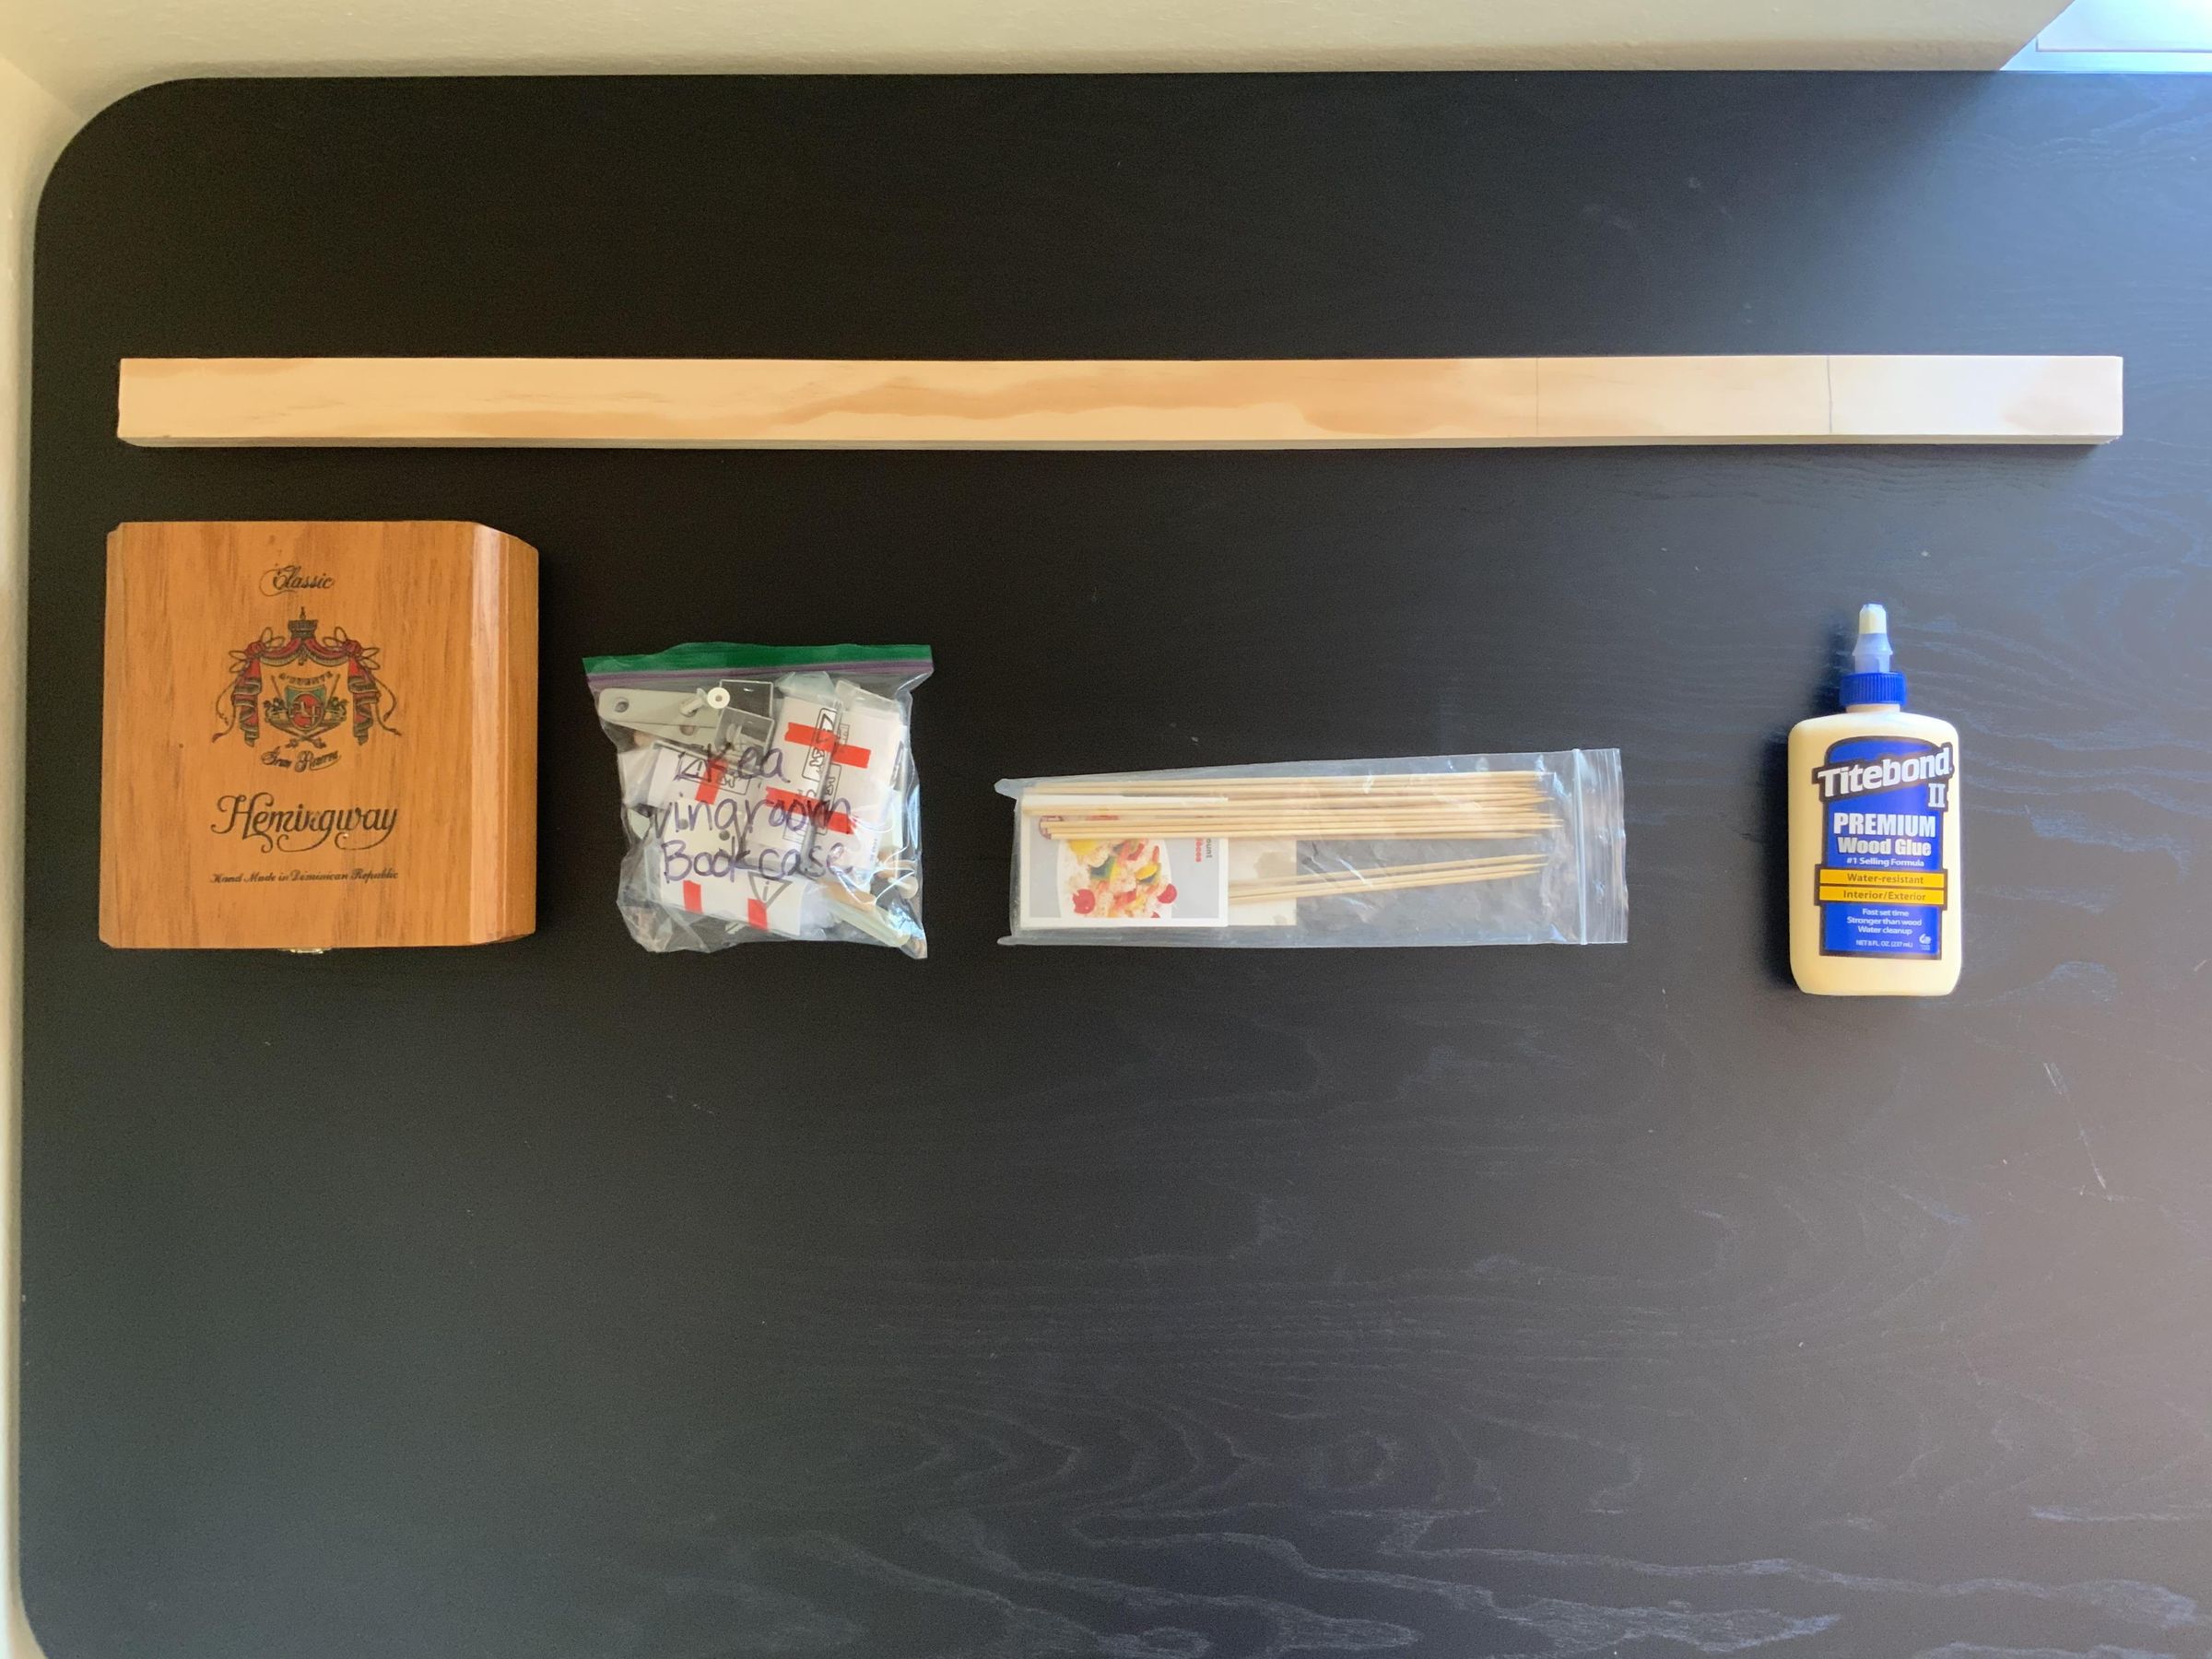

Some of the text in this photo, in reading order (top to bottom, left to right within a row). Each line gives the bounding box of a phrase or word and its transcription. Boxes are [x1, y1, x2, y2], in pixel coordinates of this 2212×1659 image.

[259, 565, 335, 596] Classic
[1818, 747, 1951, 798] Titebond
[1927, 783, 1947, 808] II
[211, 792, 398, 853] Hemingway
[1833, 812, 1936, 838] PREMIUM
[1838, 836, 1932, 857] Wood Glue
[1859, 857, 1889, 867] Selling
[1890, 858, 1925, 867] Formula
[244, 871, 276, 883] Made
[278, 872, 288, 882] in
[290, 869, 348, 882] Dominican
[350, 867, 398, 884] Republic
[1846, 873, 1924, 885] Water-resistant
[1843, 889, 1927, 901] Interior/Exterior
[1846, 916, 1882, 926] Stronger
[1862, 908, 1878, 916] Fast
[1879, 909, 1890, 917] set
[1857, 925, 1913, 936] Water cleanup
